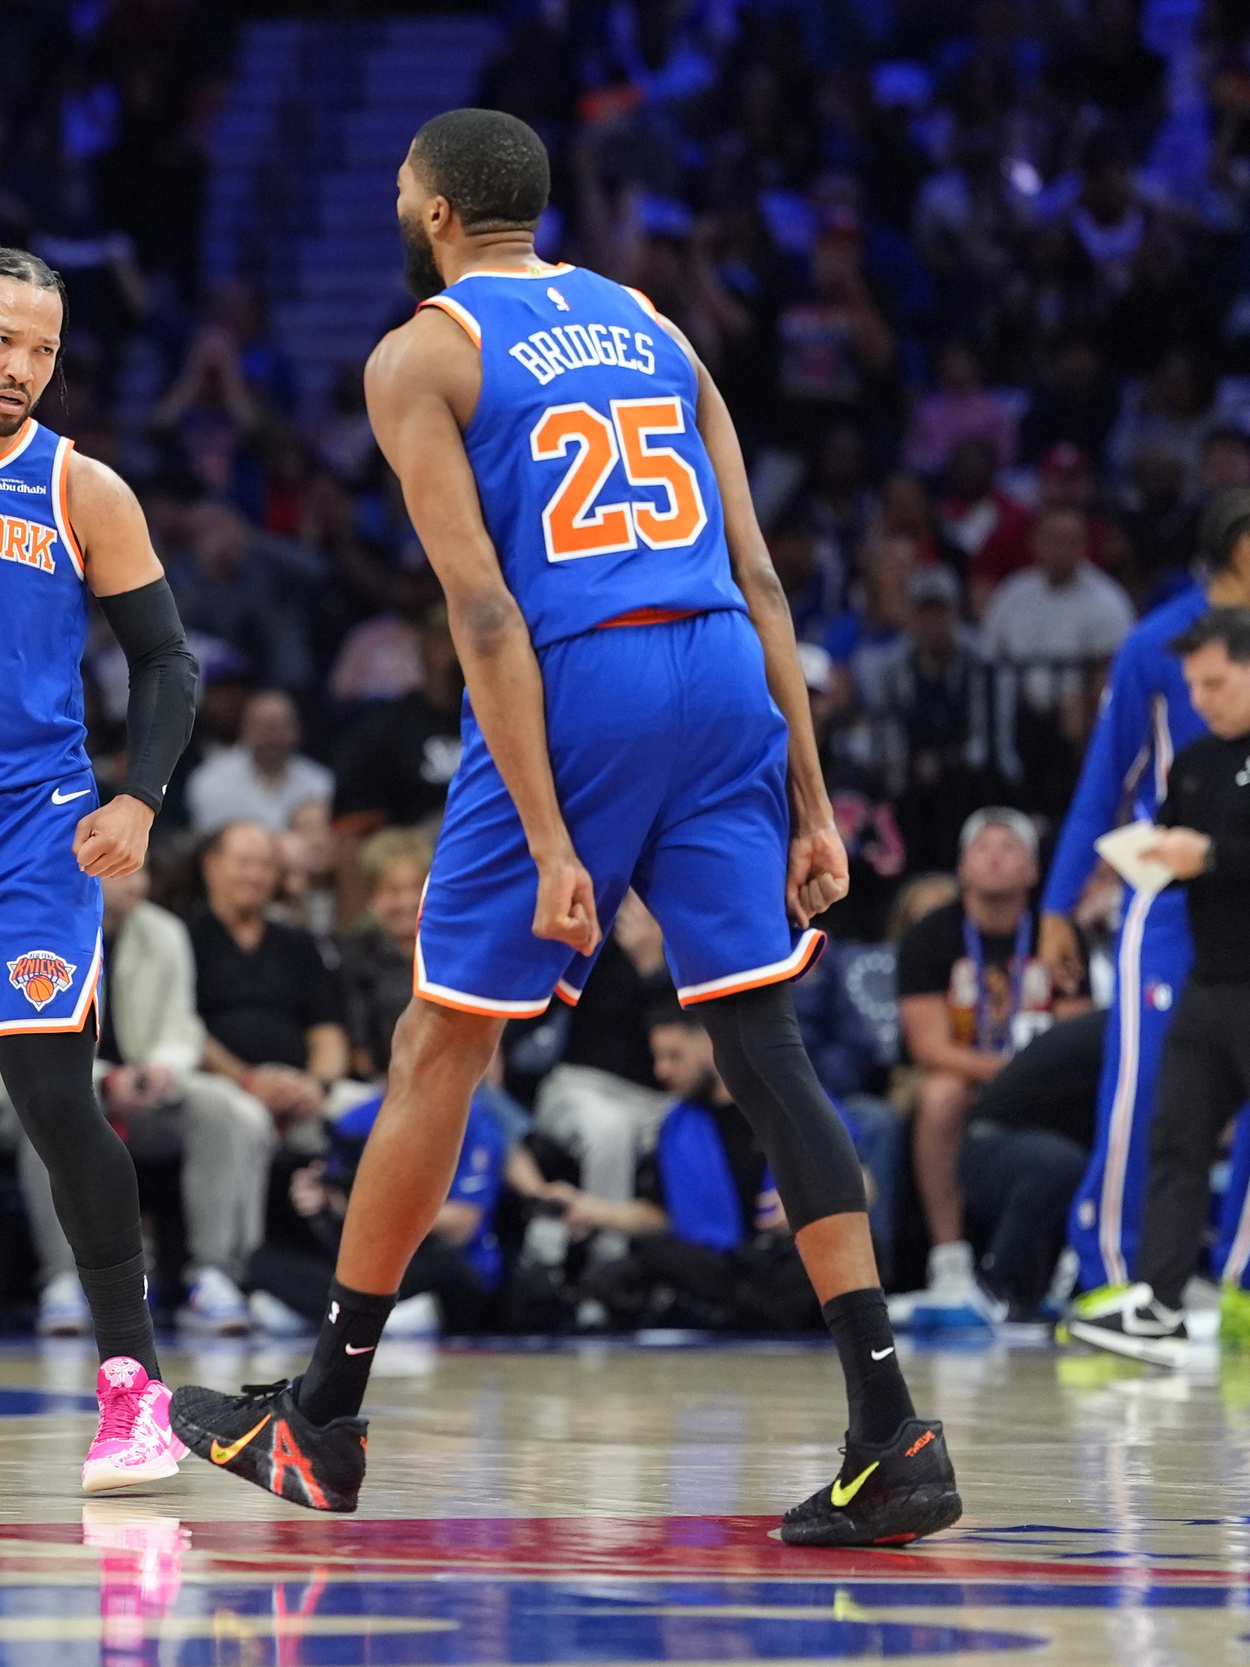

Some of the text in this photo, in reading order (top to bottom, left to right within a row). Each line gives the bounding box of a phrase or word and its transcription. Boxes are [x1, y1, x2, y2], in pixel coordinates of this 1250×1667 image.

[509, 323, 655, 385] BRIDGES
[16, 484, 47, 495] dhabi
[530, 396, 708, 562] 25
[11, 957, 71, 984] KNICKS
